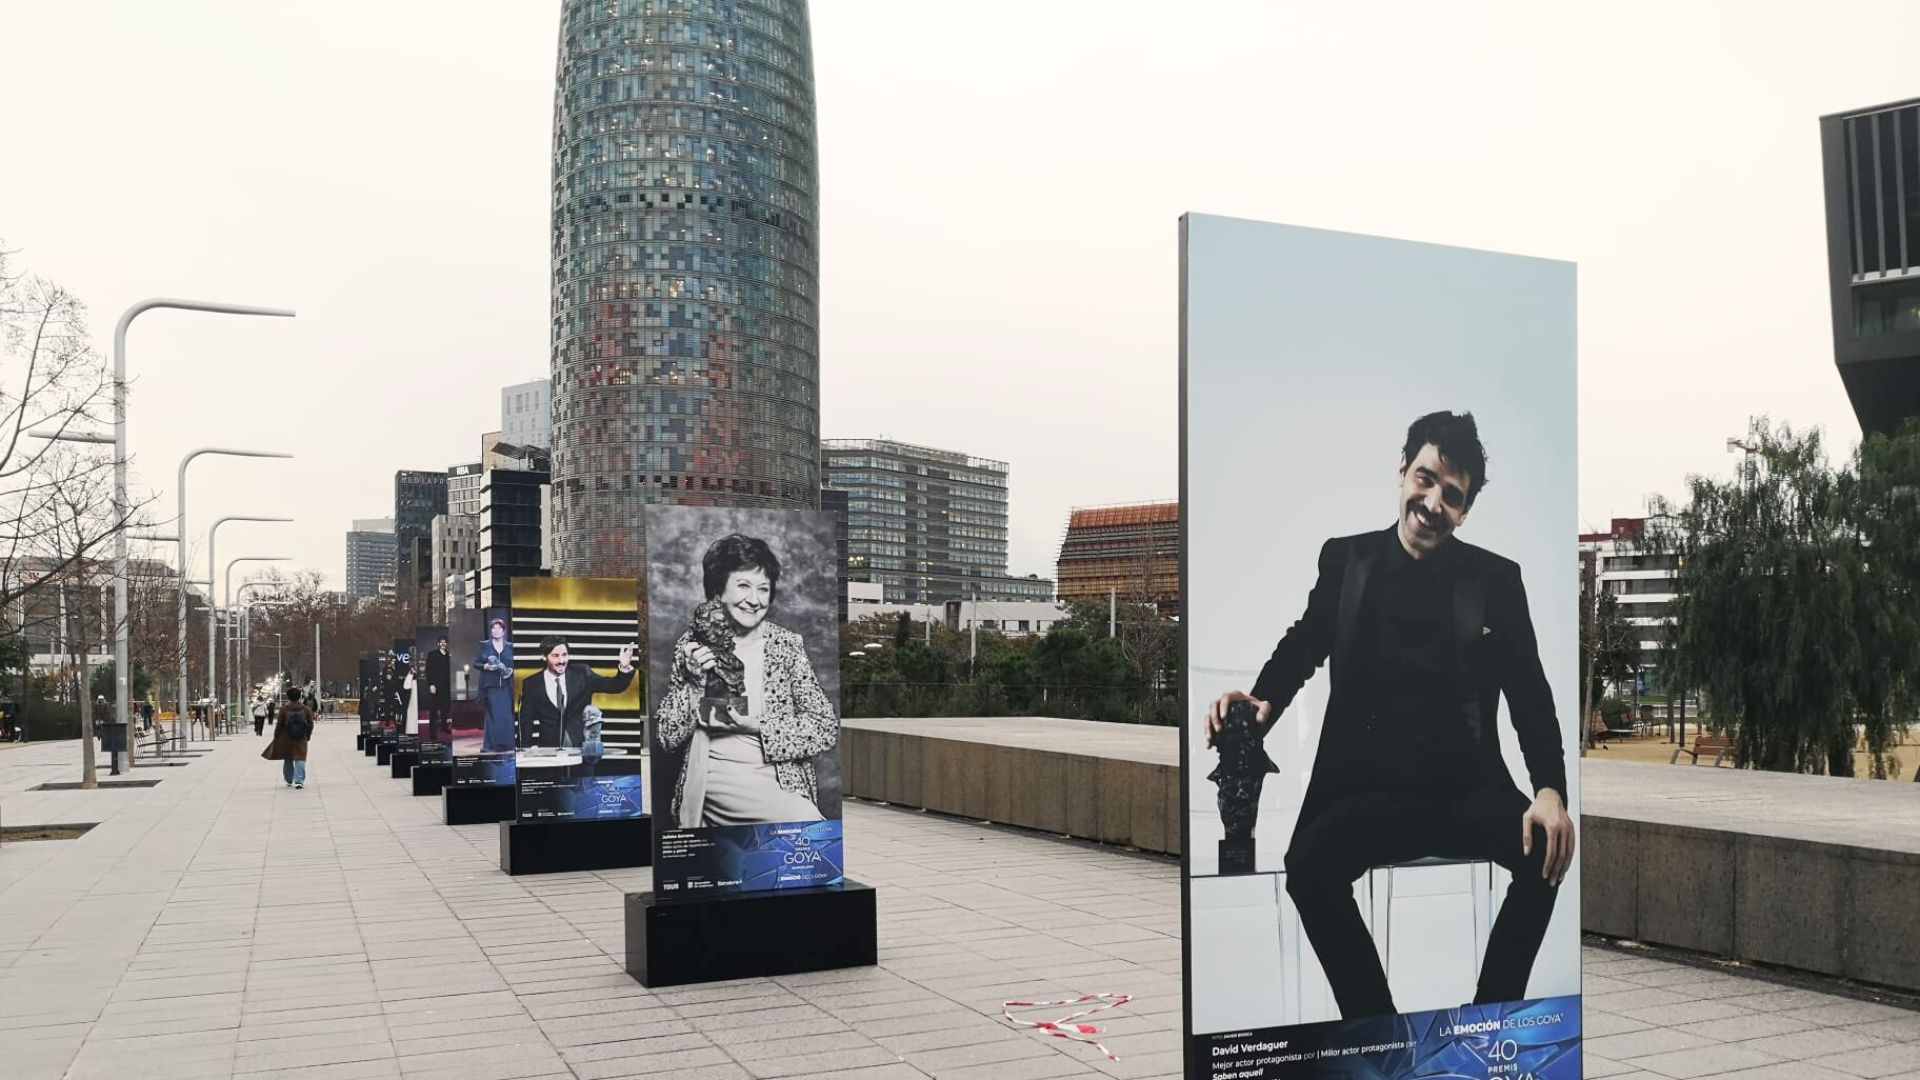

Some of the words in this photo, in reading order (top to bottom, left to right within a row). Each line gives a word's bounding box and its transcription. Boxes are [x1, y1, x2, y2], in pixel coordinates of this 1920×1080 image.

[601, 794, 626, 803] GOYA
[795, 836, 810, 847] 40
[783, 851, 821, 864] GOYA
[1439, 1026, 1453, 1037] LA
[1453, 1019, 1501, 1035] EMOCIÓN
[1502, 1019, 1516, 1029] DE
[1518, 1016, 1535, 1028] LOS
[1212, 1044, 1239, 1056] David
[1240, 1040, 1289, 1053] Verdaguer
[1488, 1039, 1518, 1062] 40
[1212, 1061, 1234, 1070] Mejor
[1235, 1059, 1254, 1068] actor
[1256, 1053, 1302, 1066] protagonista
[1303, 1051, 1315, 1060] por
[1320, 1049, 1340, 1057] Millor
[1341, 1046, 1360, 1055] actor
[1361, 1041, 1405, 1054] protagonista
[1212, 1072, 1238, 1080] Saben
[1238, 1067, 1264, 1079] aquell
[1488, 1063, 1518, 1074] PREMIS
